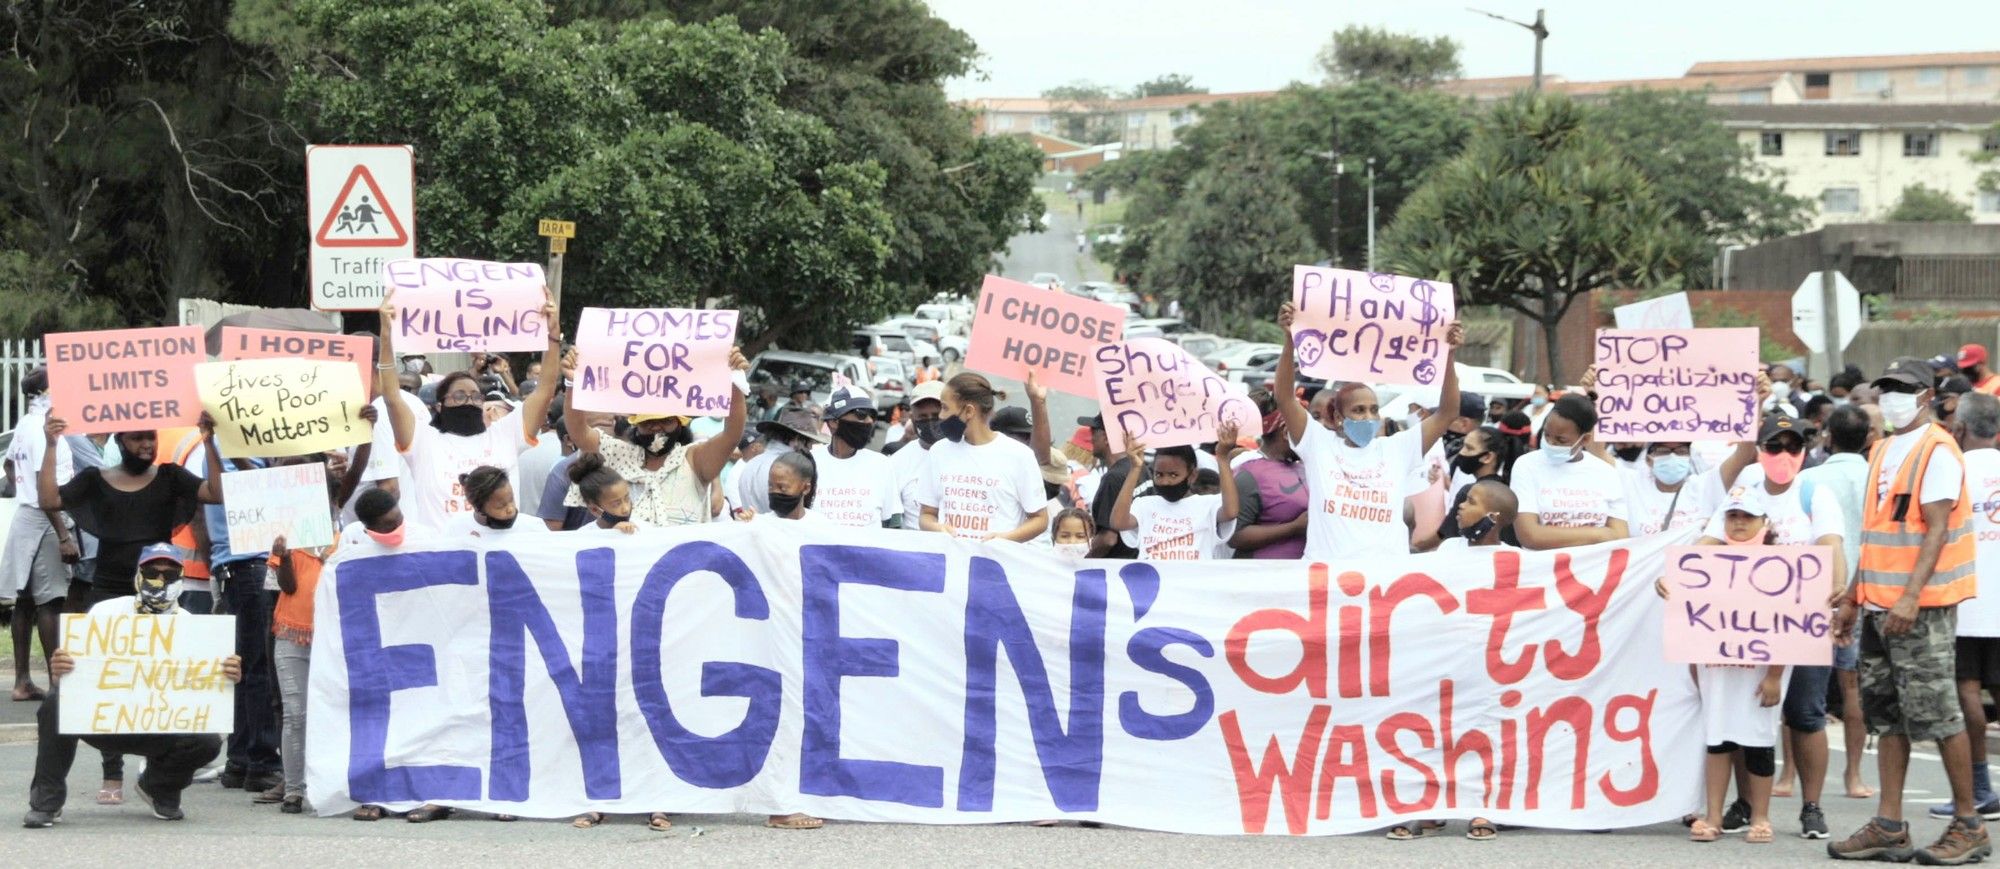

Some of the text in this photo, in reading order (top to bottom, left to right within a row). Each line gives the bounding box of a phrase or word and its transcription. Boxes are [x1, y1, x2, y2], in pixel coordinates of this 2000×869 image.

[541, 222, 564, 235] TARA
[330, 257, 385, 275] Traffi
[387, 260, 534, 288] ENGEN
[322, 281, 387, 299] Calmi
[456, 288, 492, 311] IS
[984, 293, 994, 315] I
[402, 307, 541, 338] KILLING
[607, 311, 733, 340] HOMES
[55, 336, 197, 363] EDUCATION
[240, 334, 355, 362] I HOPE,
[623, 341, 693, 373] FOR
[1002, 337, 1086, 377] HOPE!
[1095, 343, 1194, 379] Shut
[1597, 335, 1688, 364] STOP
[88, 369, 169, 392] LIMITS
[300, 365, 321, 389] of
[621, 370, 683, 399] OUR
[219, 387, 329, 422] The Poor
[1105, 376, 1227, 412] Engen
[1600, 394, 1697, 414] ON OUR
[82, 399, 181, 423] CANCER
[240, 416, 330, 446] Matters
[826, 488, 856, 496] YEARS
[945, 487, 988, 500] ENGEN'S
[1334, 483, 1388, 504] ENOUGH
[227, 507, 266, 527] BACK
[1323, 498, 1393, 524] IS ENOUGH
[1679, 553, 1822, 604] STOP
[1685, 600, 1830, 637] KILLING
[63, 613, 176, 657] ENGEN
[1719, 639, 1771, 662] US
[97, 657, 226, 693] ENOUGH
[335, 541, 1629, 812] ENGEN's dirty
[91, 702, 210, 733] ENOUGH
